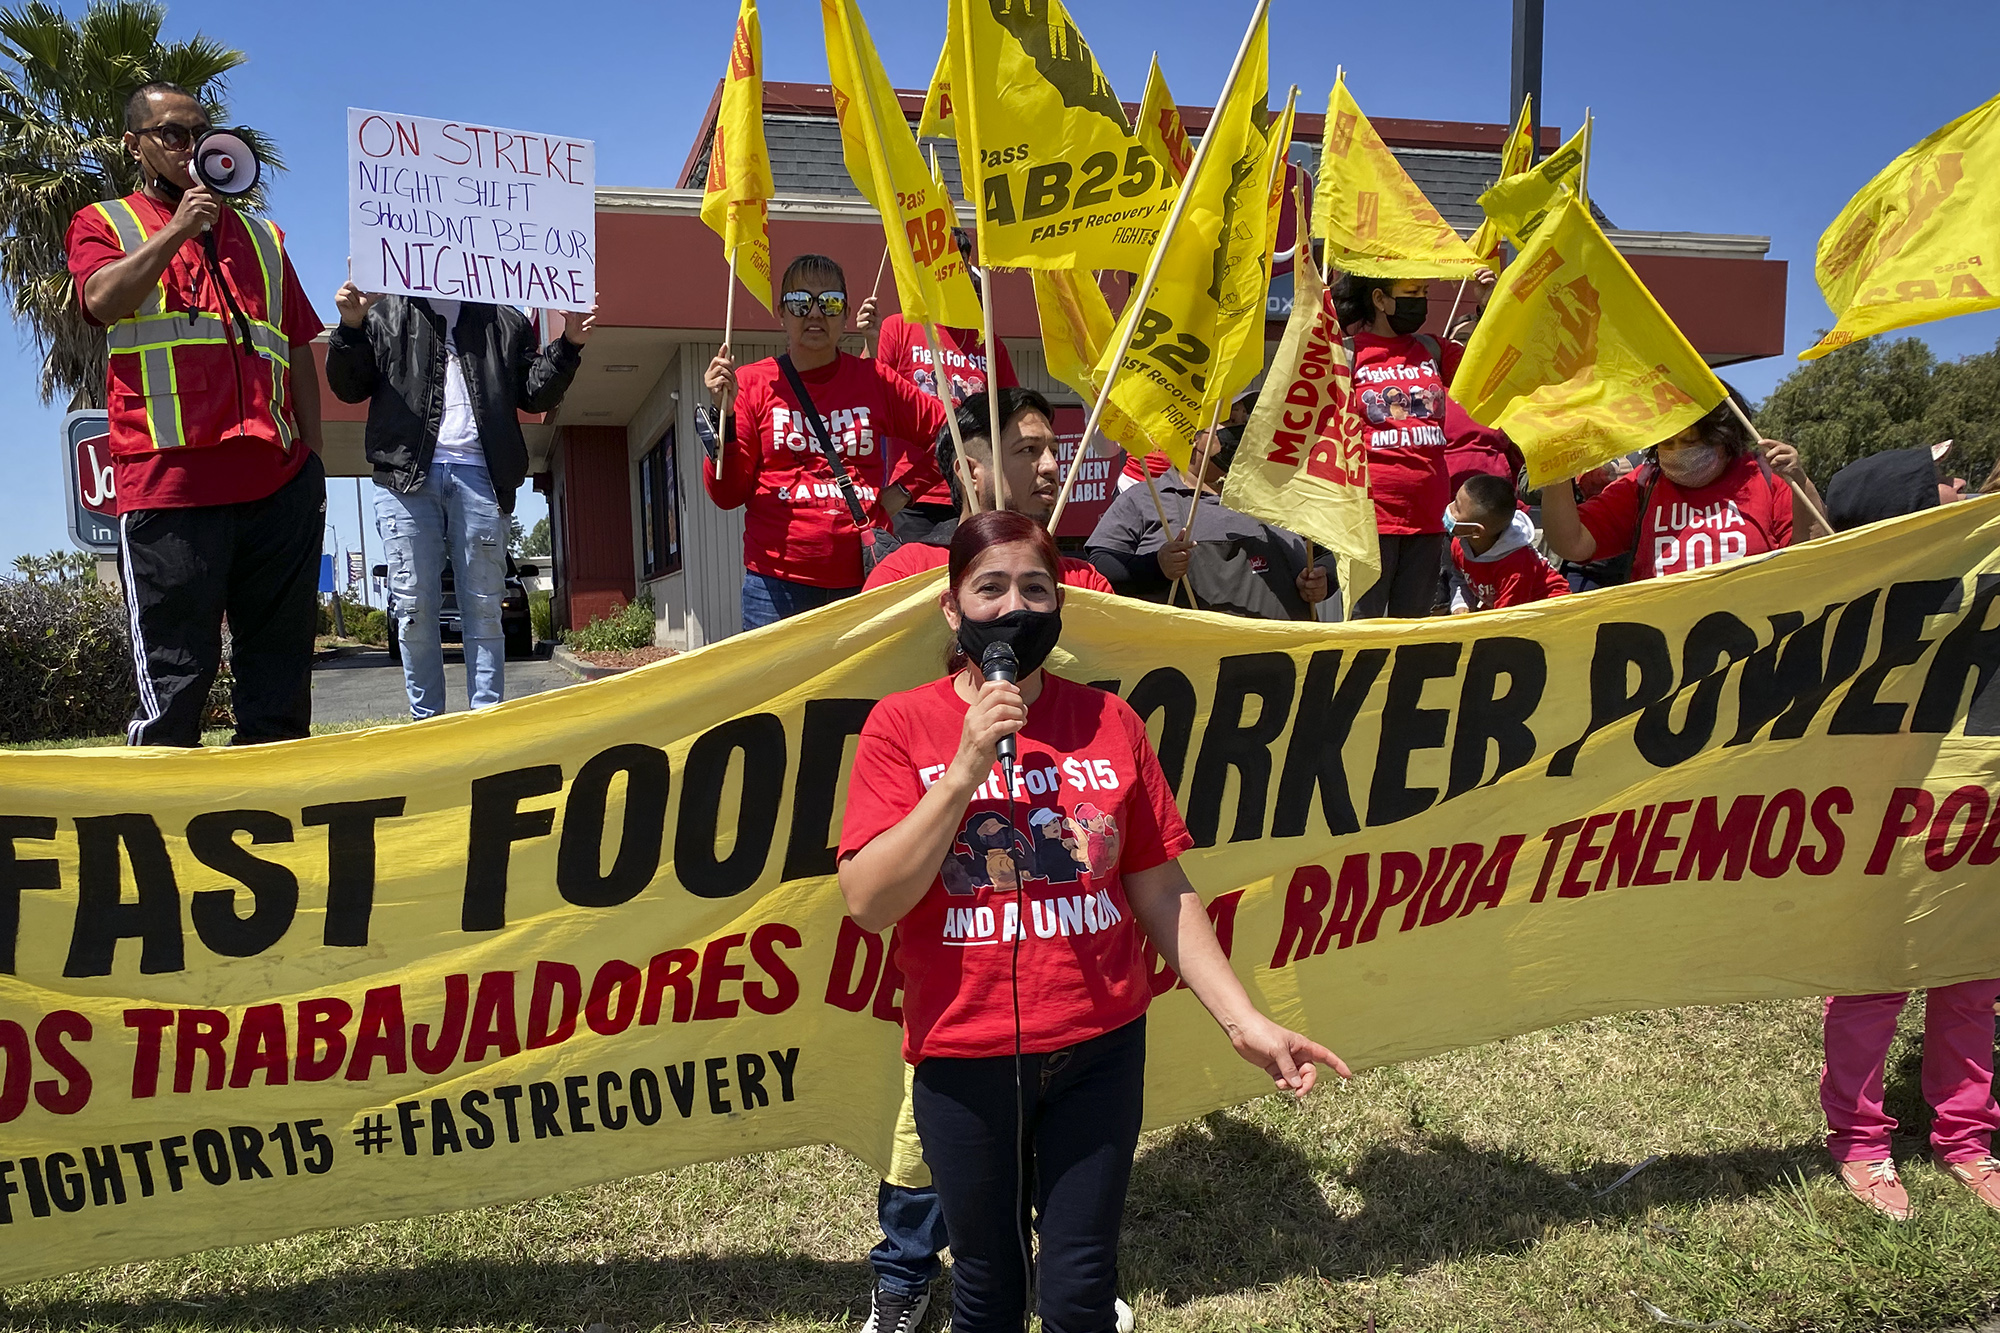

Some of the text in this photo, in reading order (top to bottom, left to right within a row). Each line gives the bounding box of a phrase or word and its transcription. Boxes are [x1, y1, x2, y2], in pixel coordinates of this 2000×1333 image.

[358, 115, 585, 186] ON STRIKE
[359, 160, 537, 212] NIGHT SHIFT
[1030, 199, 1174, 244] FAST Recovery Ac
[1111, 226, 1152, 245] FIGHT
[492, 218, 538, 252] BE
[544, 226, 594, 266] OUR
[381, 237, 587, 304] NIGHTMARE
[934, 262, 956, 283] AST
[1267, 296, 1294, 312] ox
[911, 345, 945, 365] Figt
[946, 350, 967, 368] For
[1357, 358, 1440, 384] Fight For $1
[1147, 369, 1203, 416] Recover
[772, 406, 871, 437] FIGHT
[1160, 403, 1195, 435] FIGHT
[1371, 428, 1399, 447] AND
[1401, 427, 1411, 447] A
[773, 431, 825, 454] FOR
[84, 444, 116, 506] Ja
[778, 483, 877, 502] & A UNON
[92, 525, 112, 540] in
[1654, 499, 1746, 533] LUCHA
[0, 796, 407, 978] FAST
[1091, 636, 1548, 848] ORKER
[1545, 573, 2000, 777] POWER
[919, 756, 1120, 800] Fit For $15
[942, 906, 996, 939] AND
[1002, 902, 1028, 942] A
[0, 1010, 92, 1124] OS
[123, 923, 802, 1099] TRABAJADORES
[1269, 833, 1526, 970] RAPIDA
[1529, 786, 1854, 904] TENEMOS
[0, 1046, 801, 1225] FIGHTFOR15 #FASTRECOVERY
